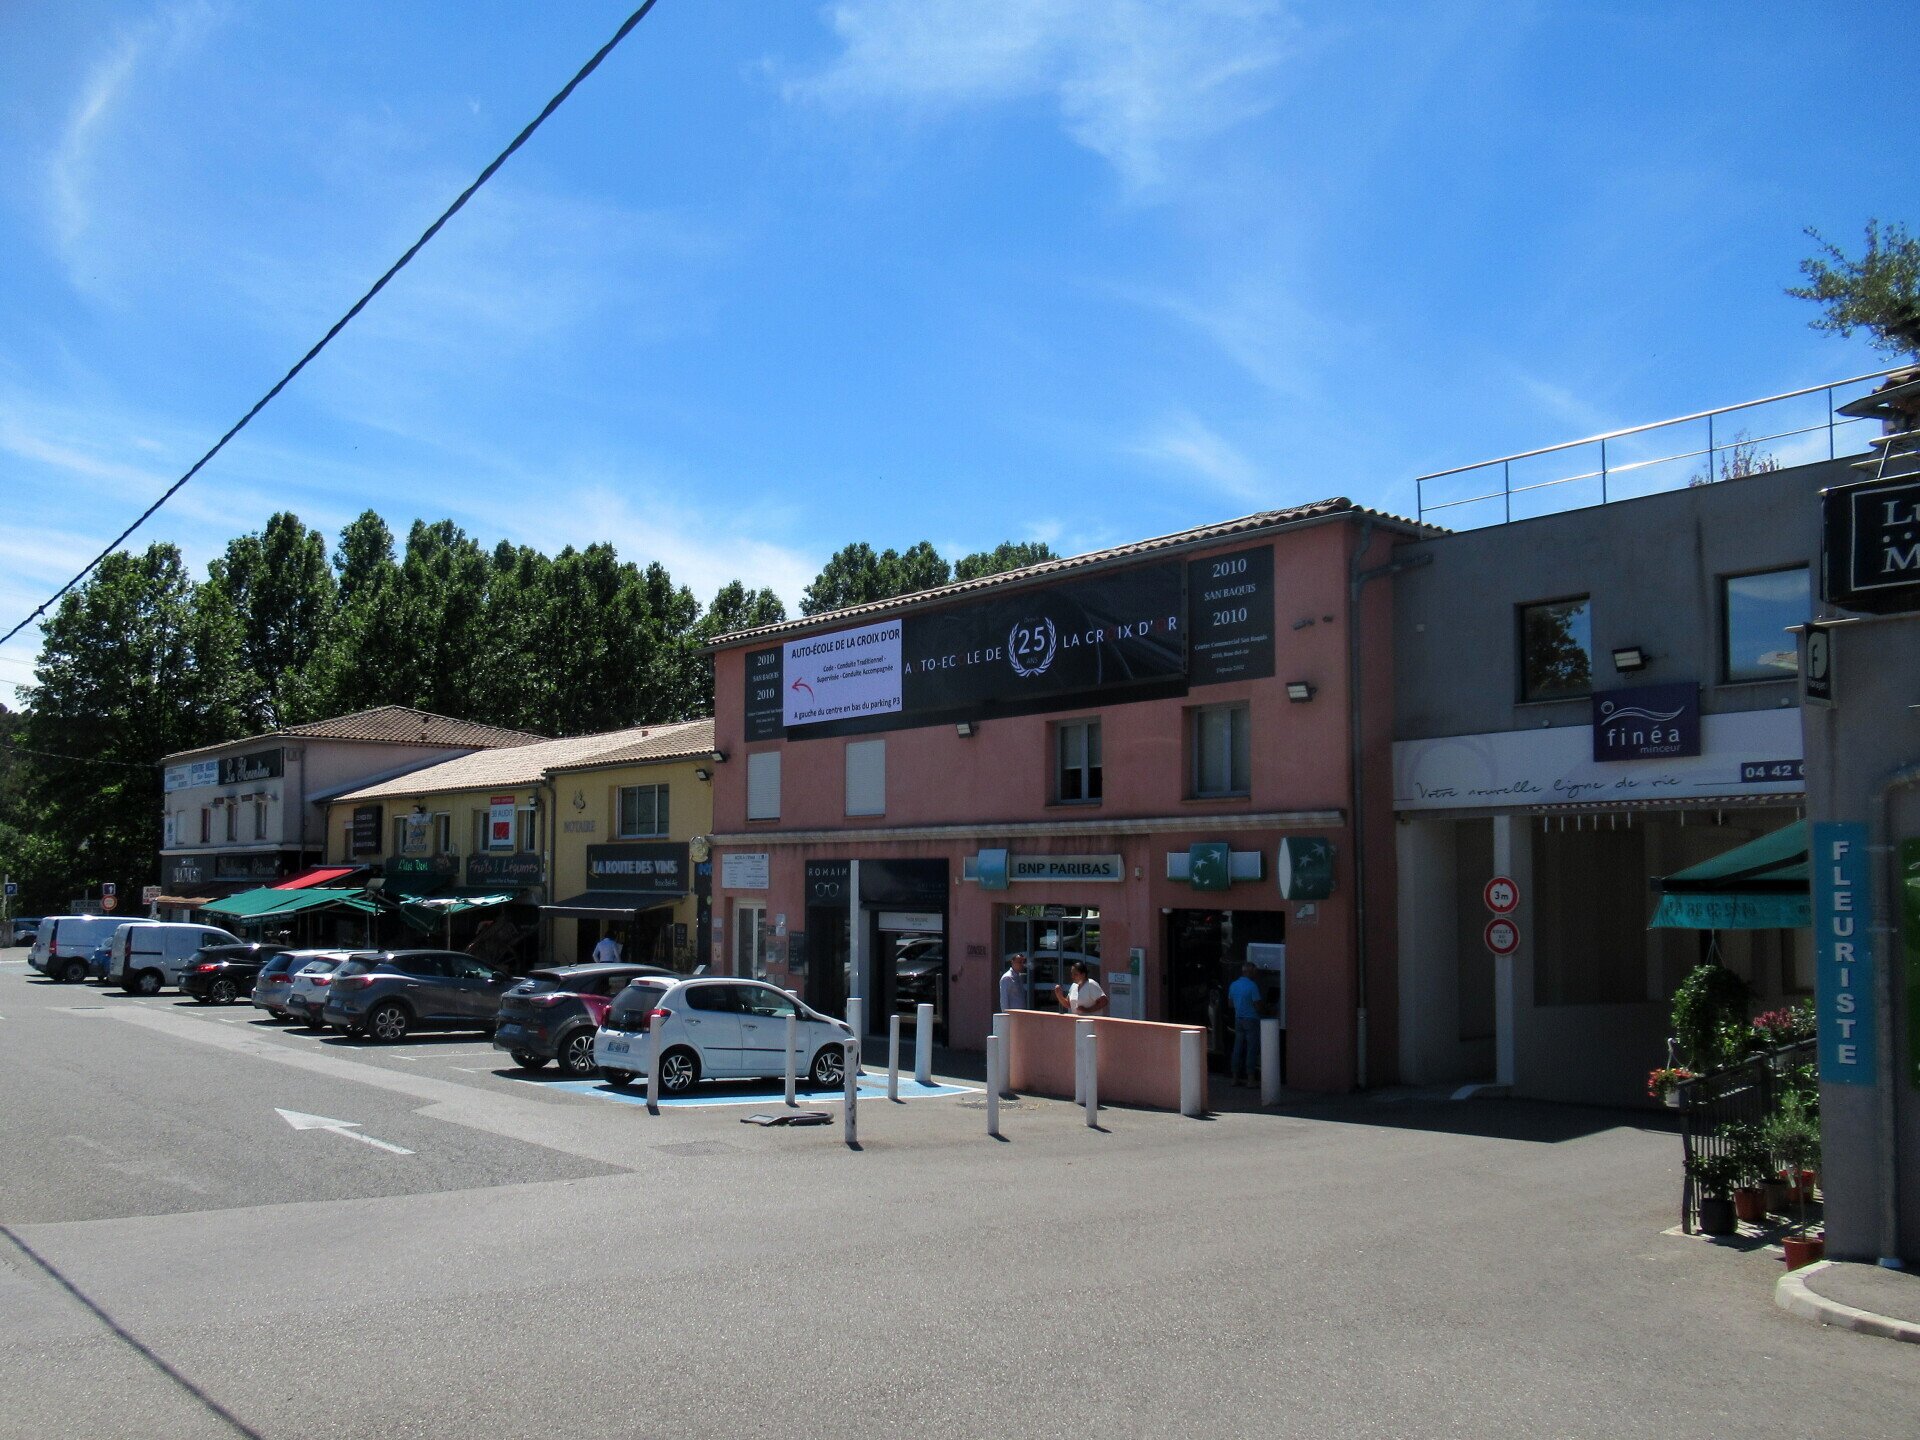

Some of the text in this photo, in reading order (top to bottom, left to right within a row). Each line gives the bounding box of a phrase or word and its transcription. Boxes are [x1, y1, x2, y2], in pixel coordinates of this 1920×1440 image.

[1882, 500, 1920, 526] L
[1213, 559, 1247, 578] 2010
[1204, 584, 1256, 601] SAN BAQUIS
[1213, 608, 1247, 626] 2010
[791, 628, 900, 659] AUTO-ÉCOLE DE LA CROIX D'OR
[1018, 626, 1045, 654] 25
[1064, 633, 1080, 648] LA
[757, 653, 775, 666] 2010
[986, 647, 1002, 661] DE
[823, 655, 884, 673] Code Conduite Traditionnel
[816, 664, 893, 684] Supervisée Conduite Accompagnée
[757, 688, 775, 700] 2010
[799, 709, 817, 721] gauche
[818, 707, 825, 716] du
[826, 706, 842, 715] centre
[844, 704, 850, 712] en
[852, 703, 861, 711] bas
[862, 701, 870, 710] du
[871, 698, 892, 710] parking
[893, 696, 901, 705] P3
[1607, 725, 1680, 746] finéa
[1640, 744, 1681, 754] minceur
[1746, 767, 1765, 778] 04
[1772, 765, 1791, 776] 42
[1416, 774, 1682, 800] Votre nouvelle ligne de vie
[470, 859, 492, 873] Fruits
[502, 859, 539, 876] Légumes
[593, 860, 678, 874] LA ROUTE DES VINS
[808, 868, 848, 877] ROMAIN
[1018, 863, 1110, 876] BNP PARIBAS
[1832, 840, 1857, 1065] FLEURISTE
